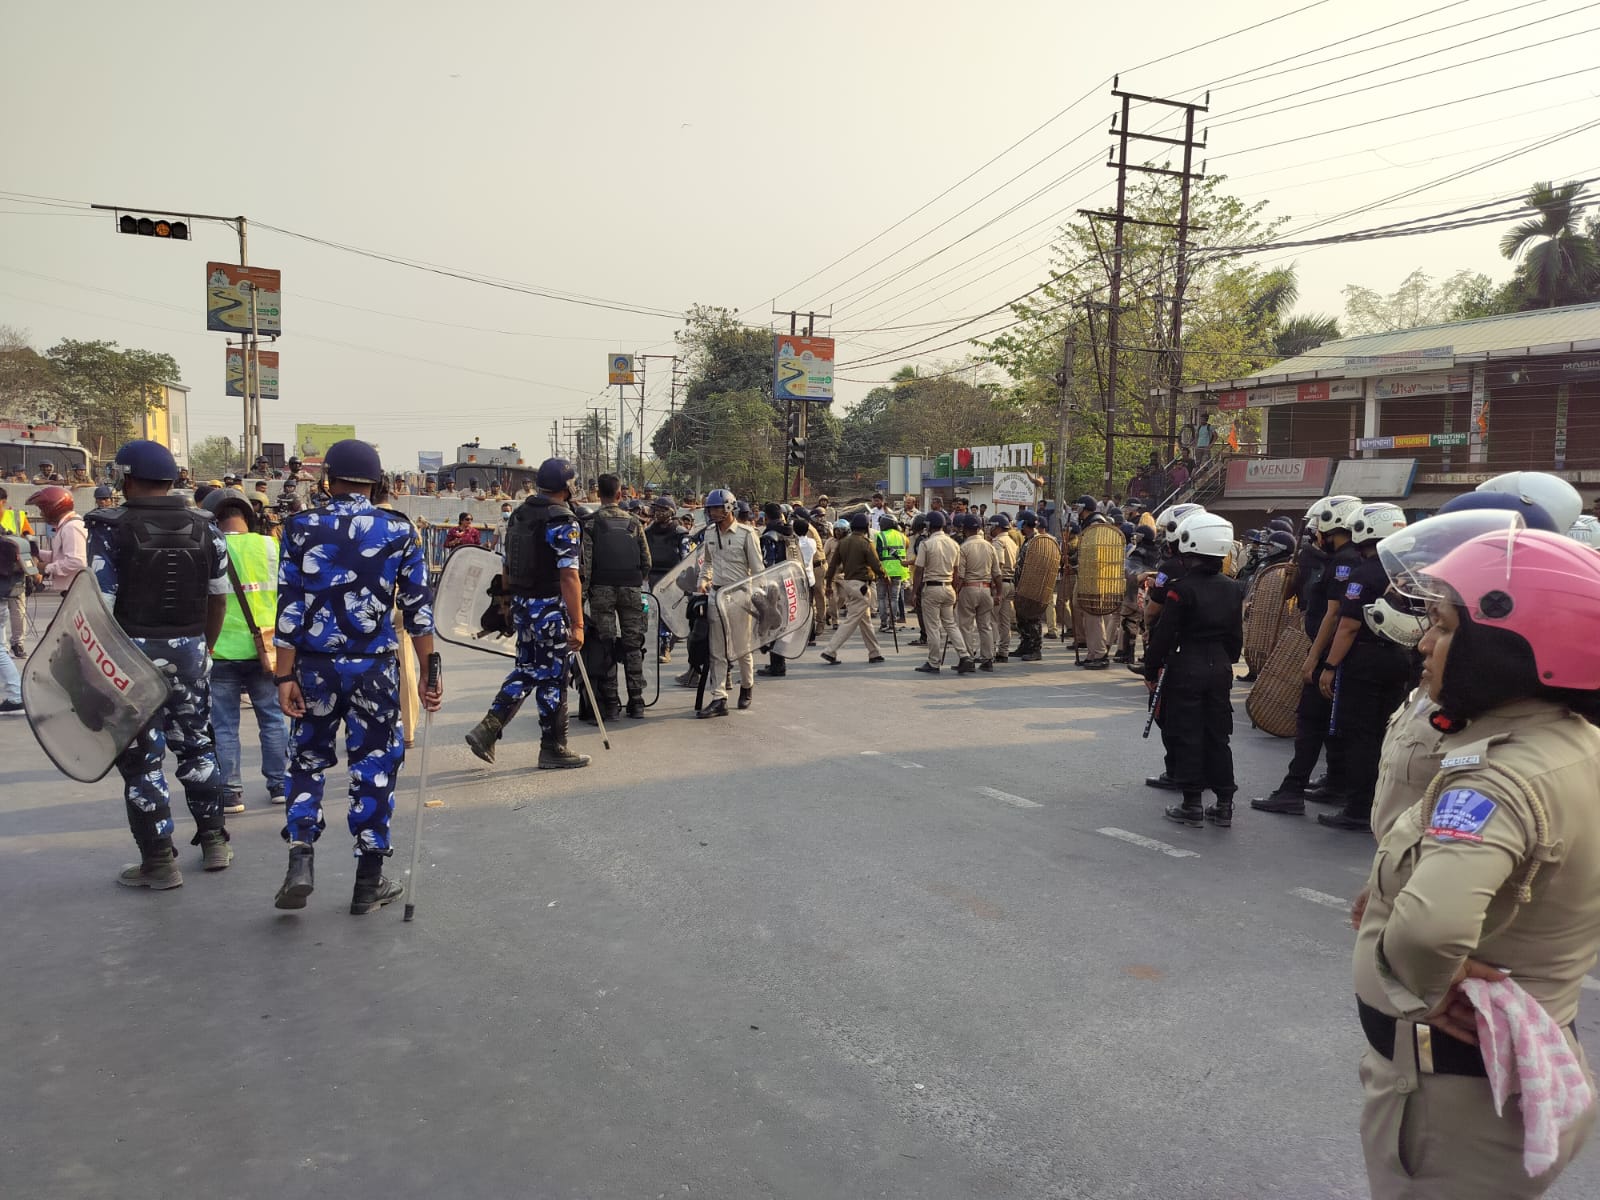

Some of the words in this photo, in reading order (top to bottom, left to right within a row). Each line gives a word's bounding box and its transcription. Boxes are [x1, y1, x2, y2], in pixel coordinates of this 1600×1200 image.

[1432, 432, 1466, 440] PRINTING
[971, 442, 1033, 469] TINBATTI
[1260, 463, 1301, 476] VENUS
[785, 578, 797, 622] POLICE
[73, 609, 130, 692] POLICE
